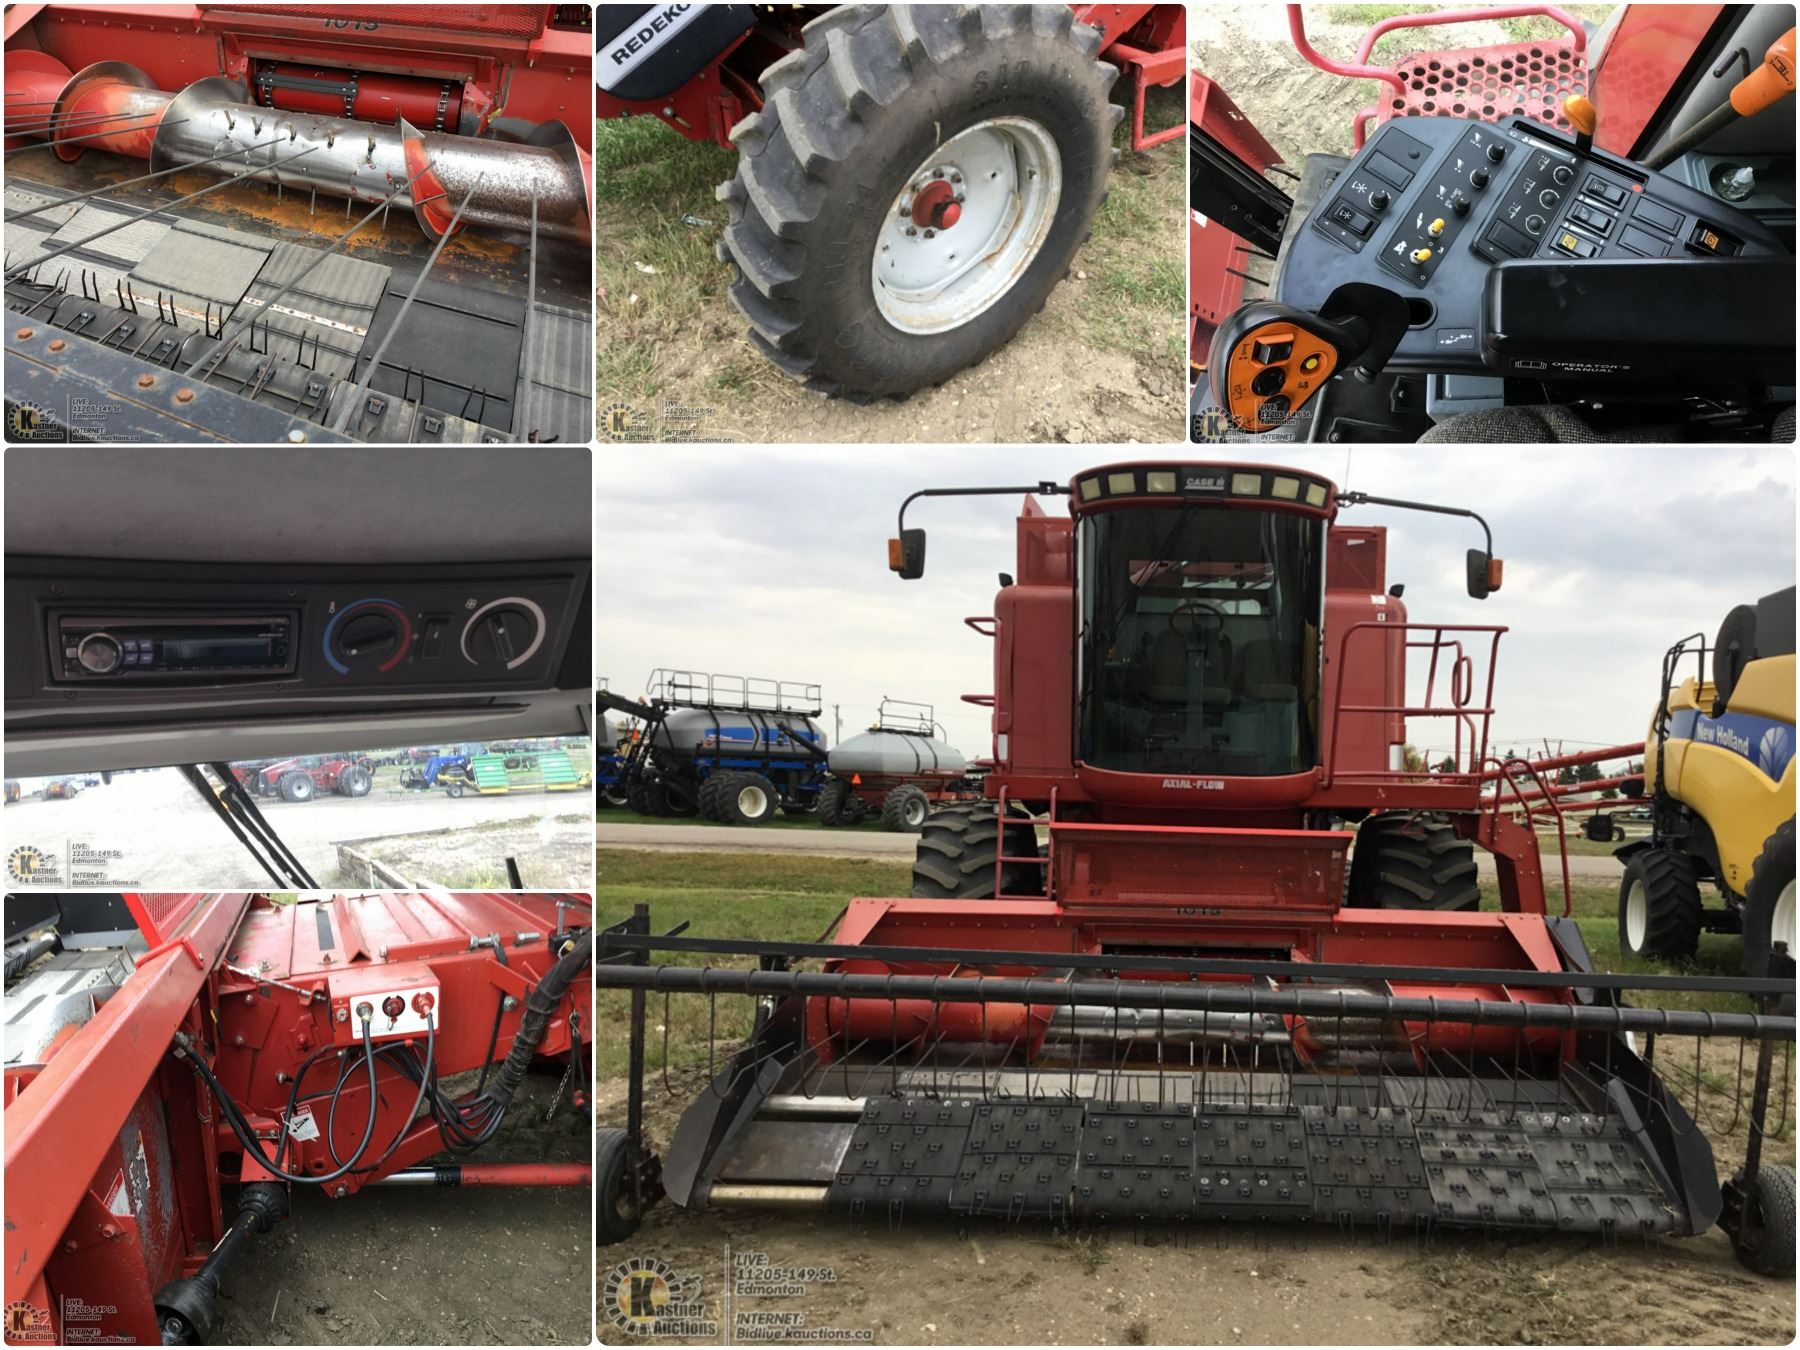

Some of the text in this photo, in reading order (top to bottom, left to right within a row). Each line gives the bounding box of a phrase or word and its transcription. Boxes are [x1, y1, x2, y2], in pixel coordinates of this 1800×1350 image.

[1552, 361, 1630, 370] OPERATOR'S
[1186, 478, 1215, 486] CASE
[1696, 721, 1749, 757] New Holland
[1162, 779, 1224, 790] AXIAL-FLOW
